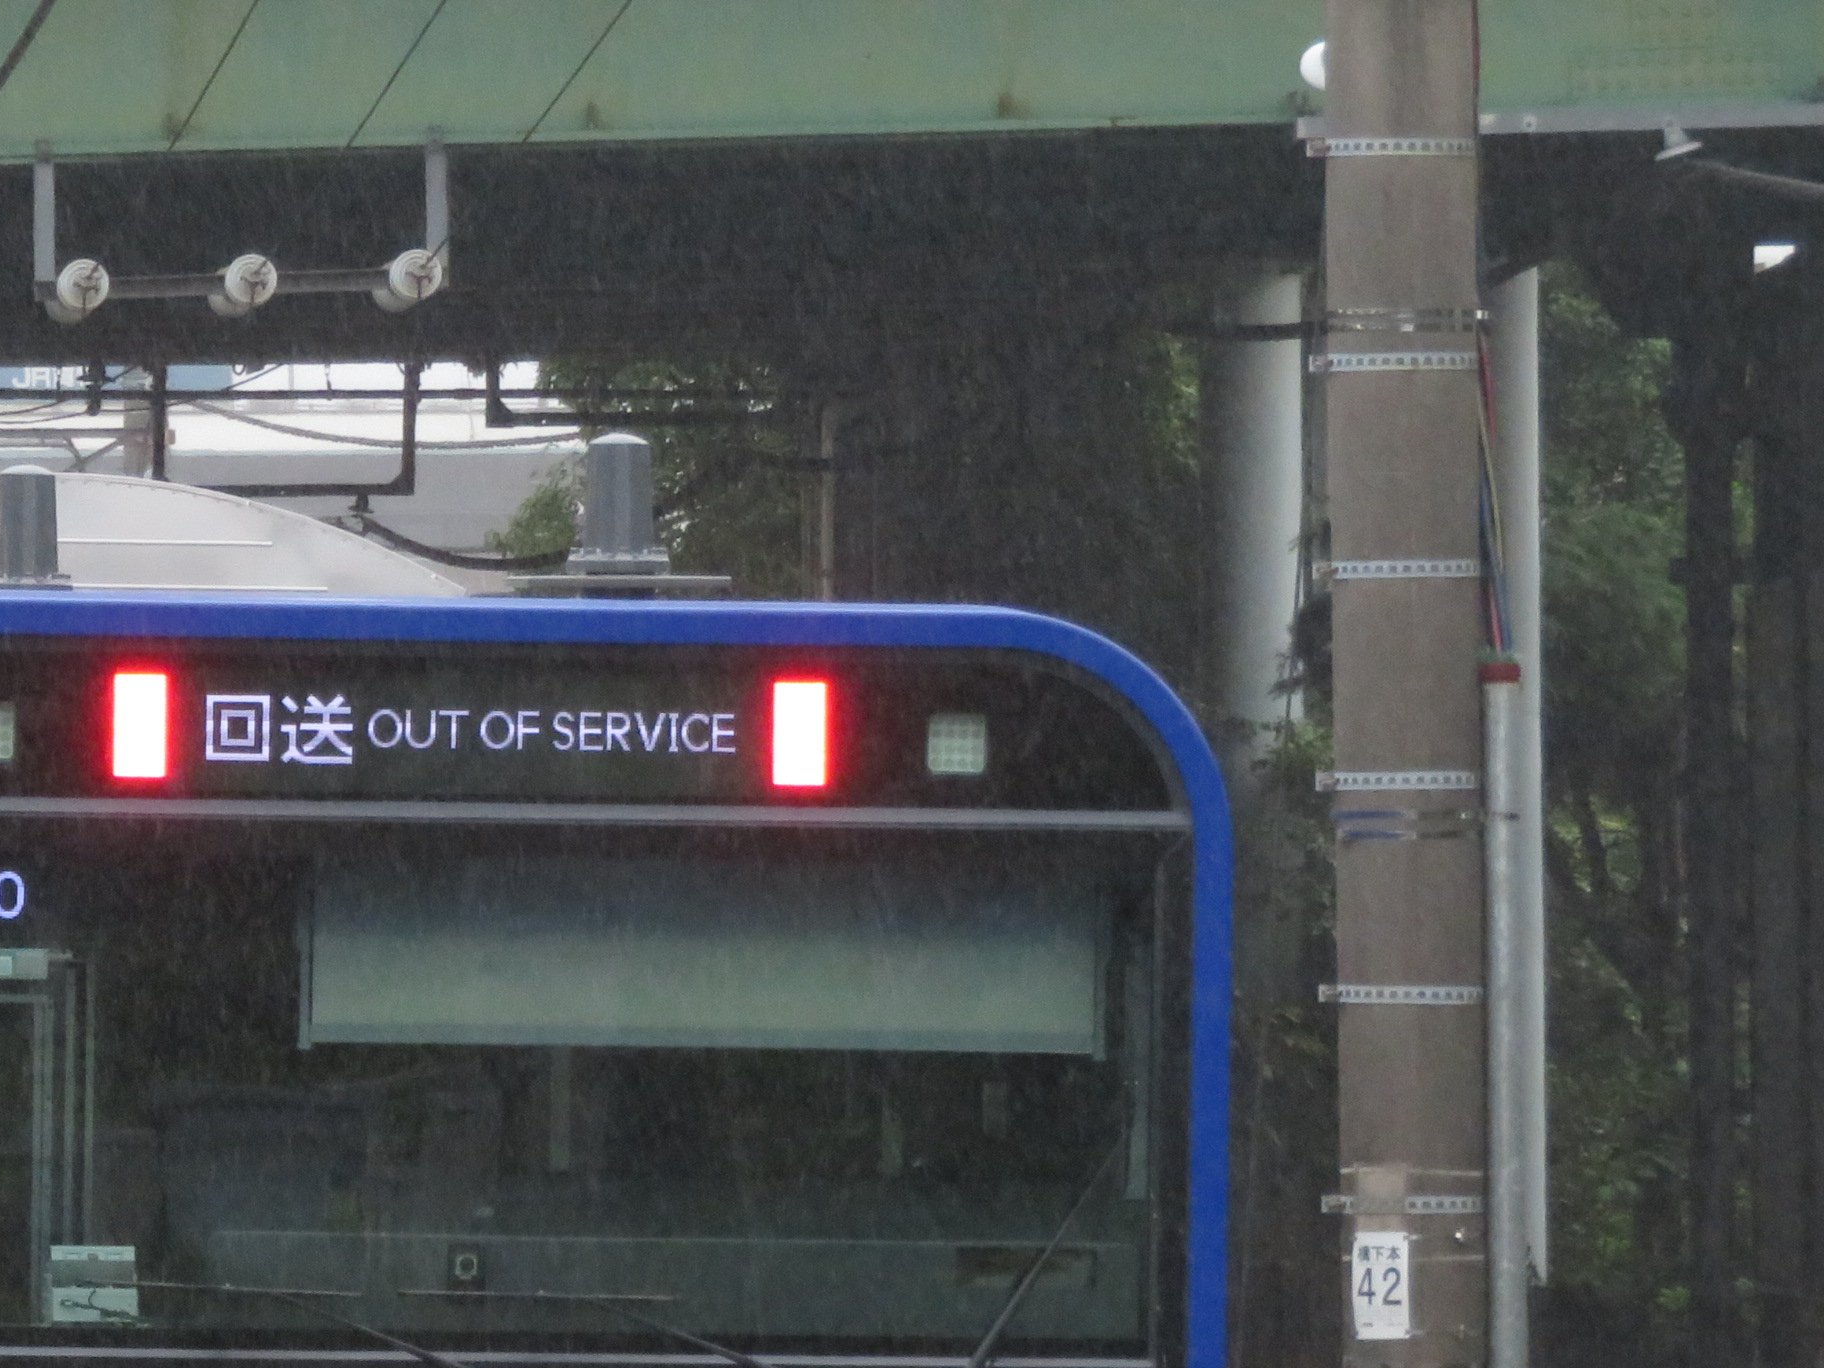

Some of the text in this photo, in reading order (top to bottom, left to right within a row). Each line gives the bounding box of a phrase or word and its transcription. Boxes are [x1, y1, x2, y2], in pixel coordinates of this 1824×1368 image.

[205, 693, 736, 765] 回送 OUT OF SERVICE
[1357, 1266, 1402, 1306] 42
